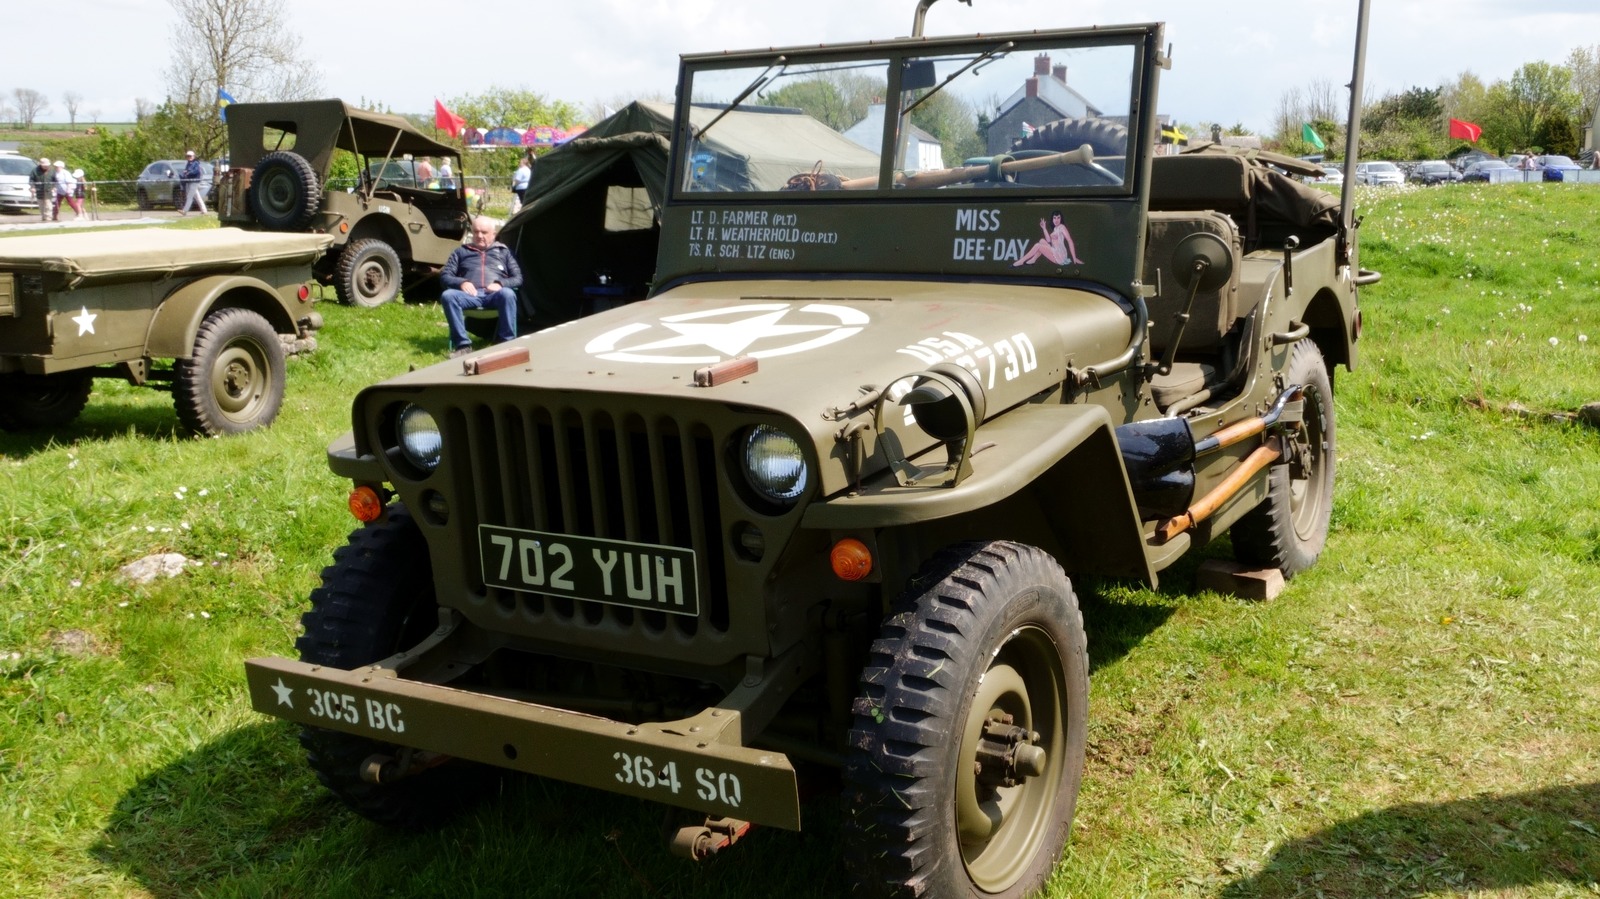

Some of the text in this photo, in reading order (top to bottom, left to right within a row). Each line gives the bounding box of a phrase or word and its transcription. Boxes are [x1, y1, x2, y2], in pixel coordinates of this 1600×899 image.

[691, 210, 704, 225] LT.
[709, 211, 719, 225] D.
[722, 211, 769, 226] FARMER
[955, 209, 1001, 231] MISS
[689, 226, 703, 241] LT.
[707, 227, 718, 241] H.
[721, 227, 800, 242] WEATHERHOLD
[705, 243, 716, 257] R.
[719, 244, 766, 259] SCHLTZ
[491, 534, 684, 605] 702 YUH
[306, 688, 405, 733] 305 BG
[613, 752, 741, 807] 364 SQ
